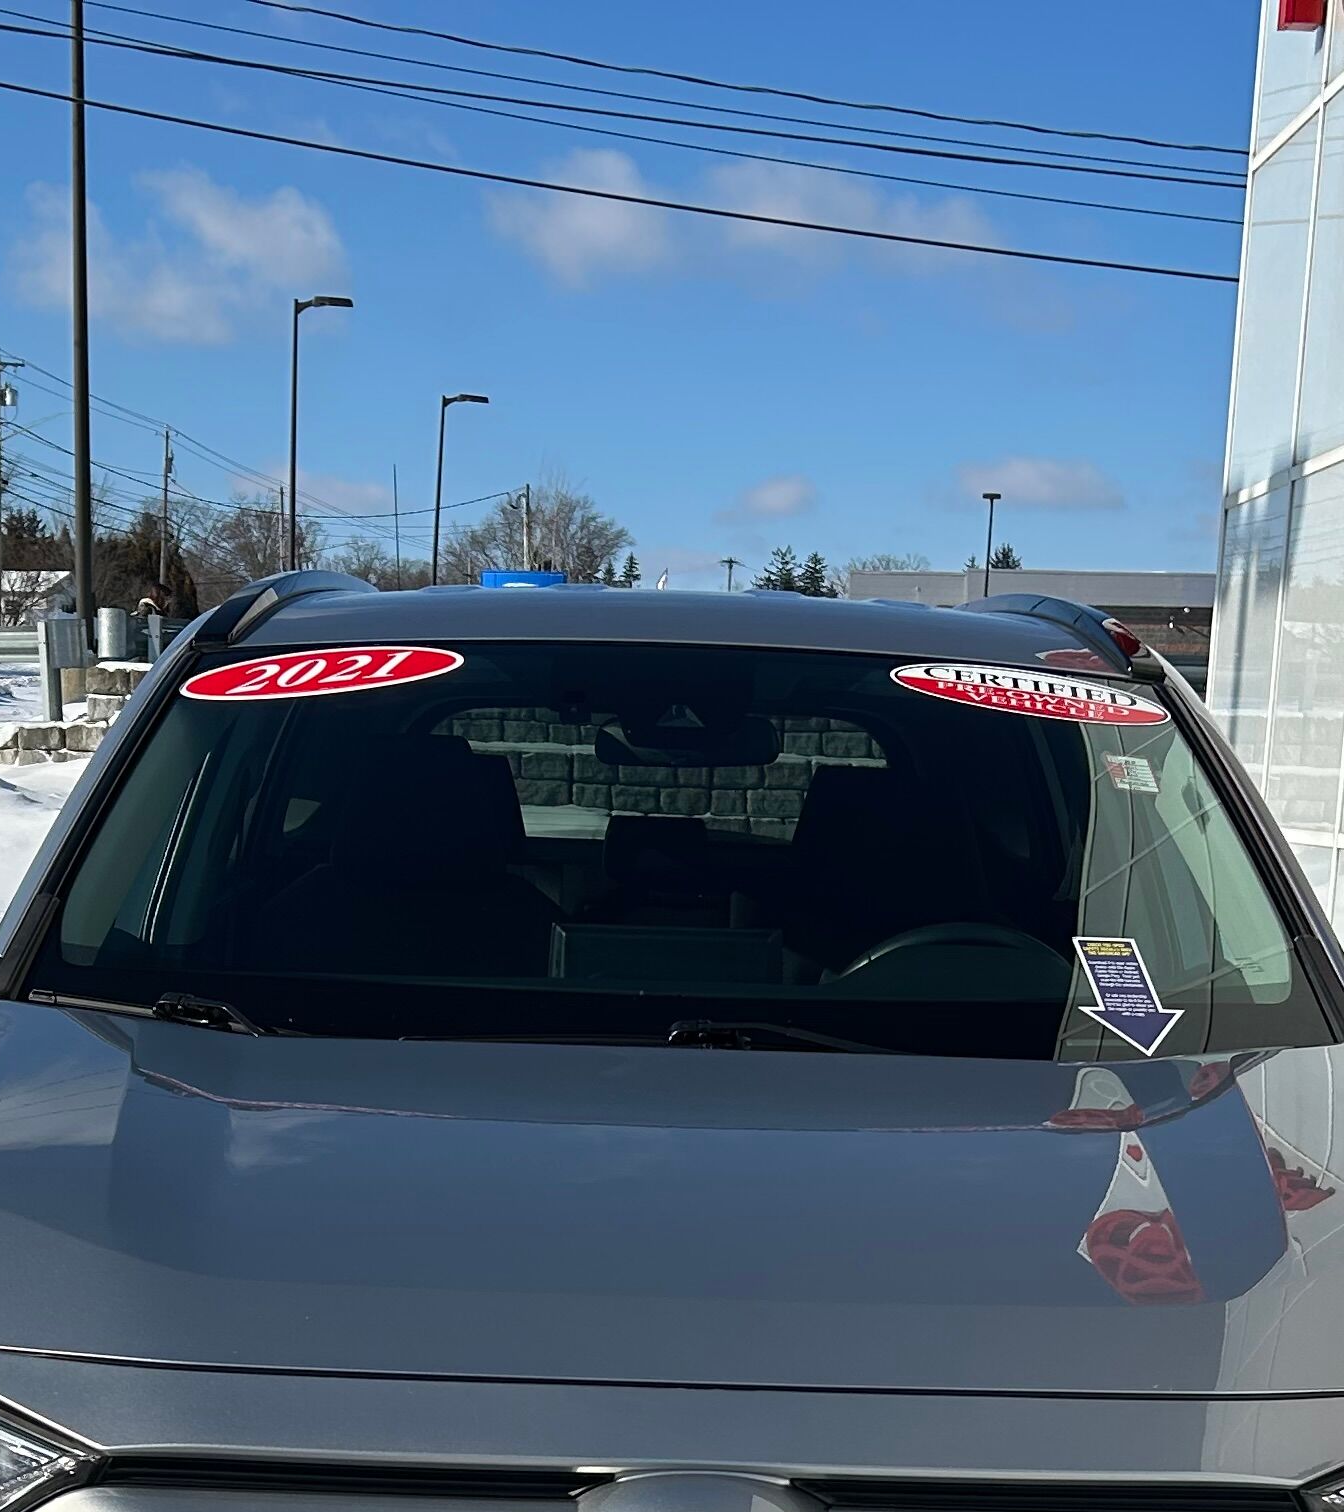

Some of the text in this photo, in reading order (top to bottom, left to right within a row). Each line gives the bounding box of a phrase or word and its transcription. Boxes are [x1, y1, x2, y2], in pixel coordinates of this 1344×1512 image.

[225, 651, 413, 694] 2021
[923, 667, 1137, 707] CERTIFIED
[936, 681, 1130, 716] PRE-OWNED
[967, 692, 1105, 720] VEHICLE
